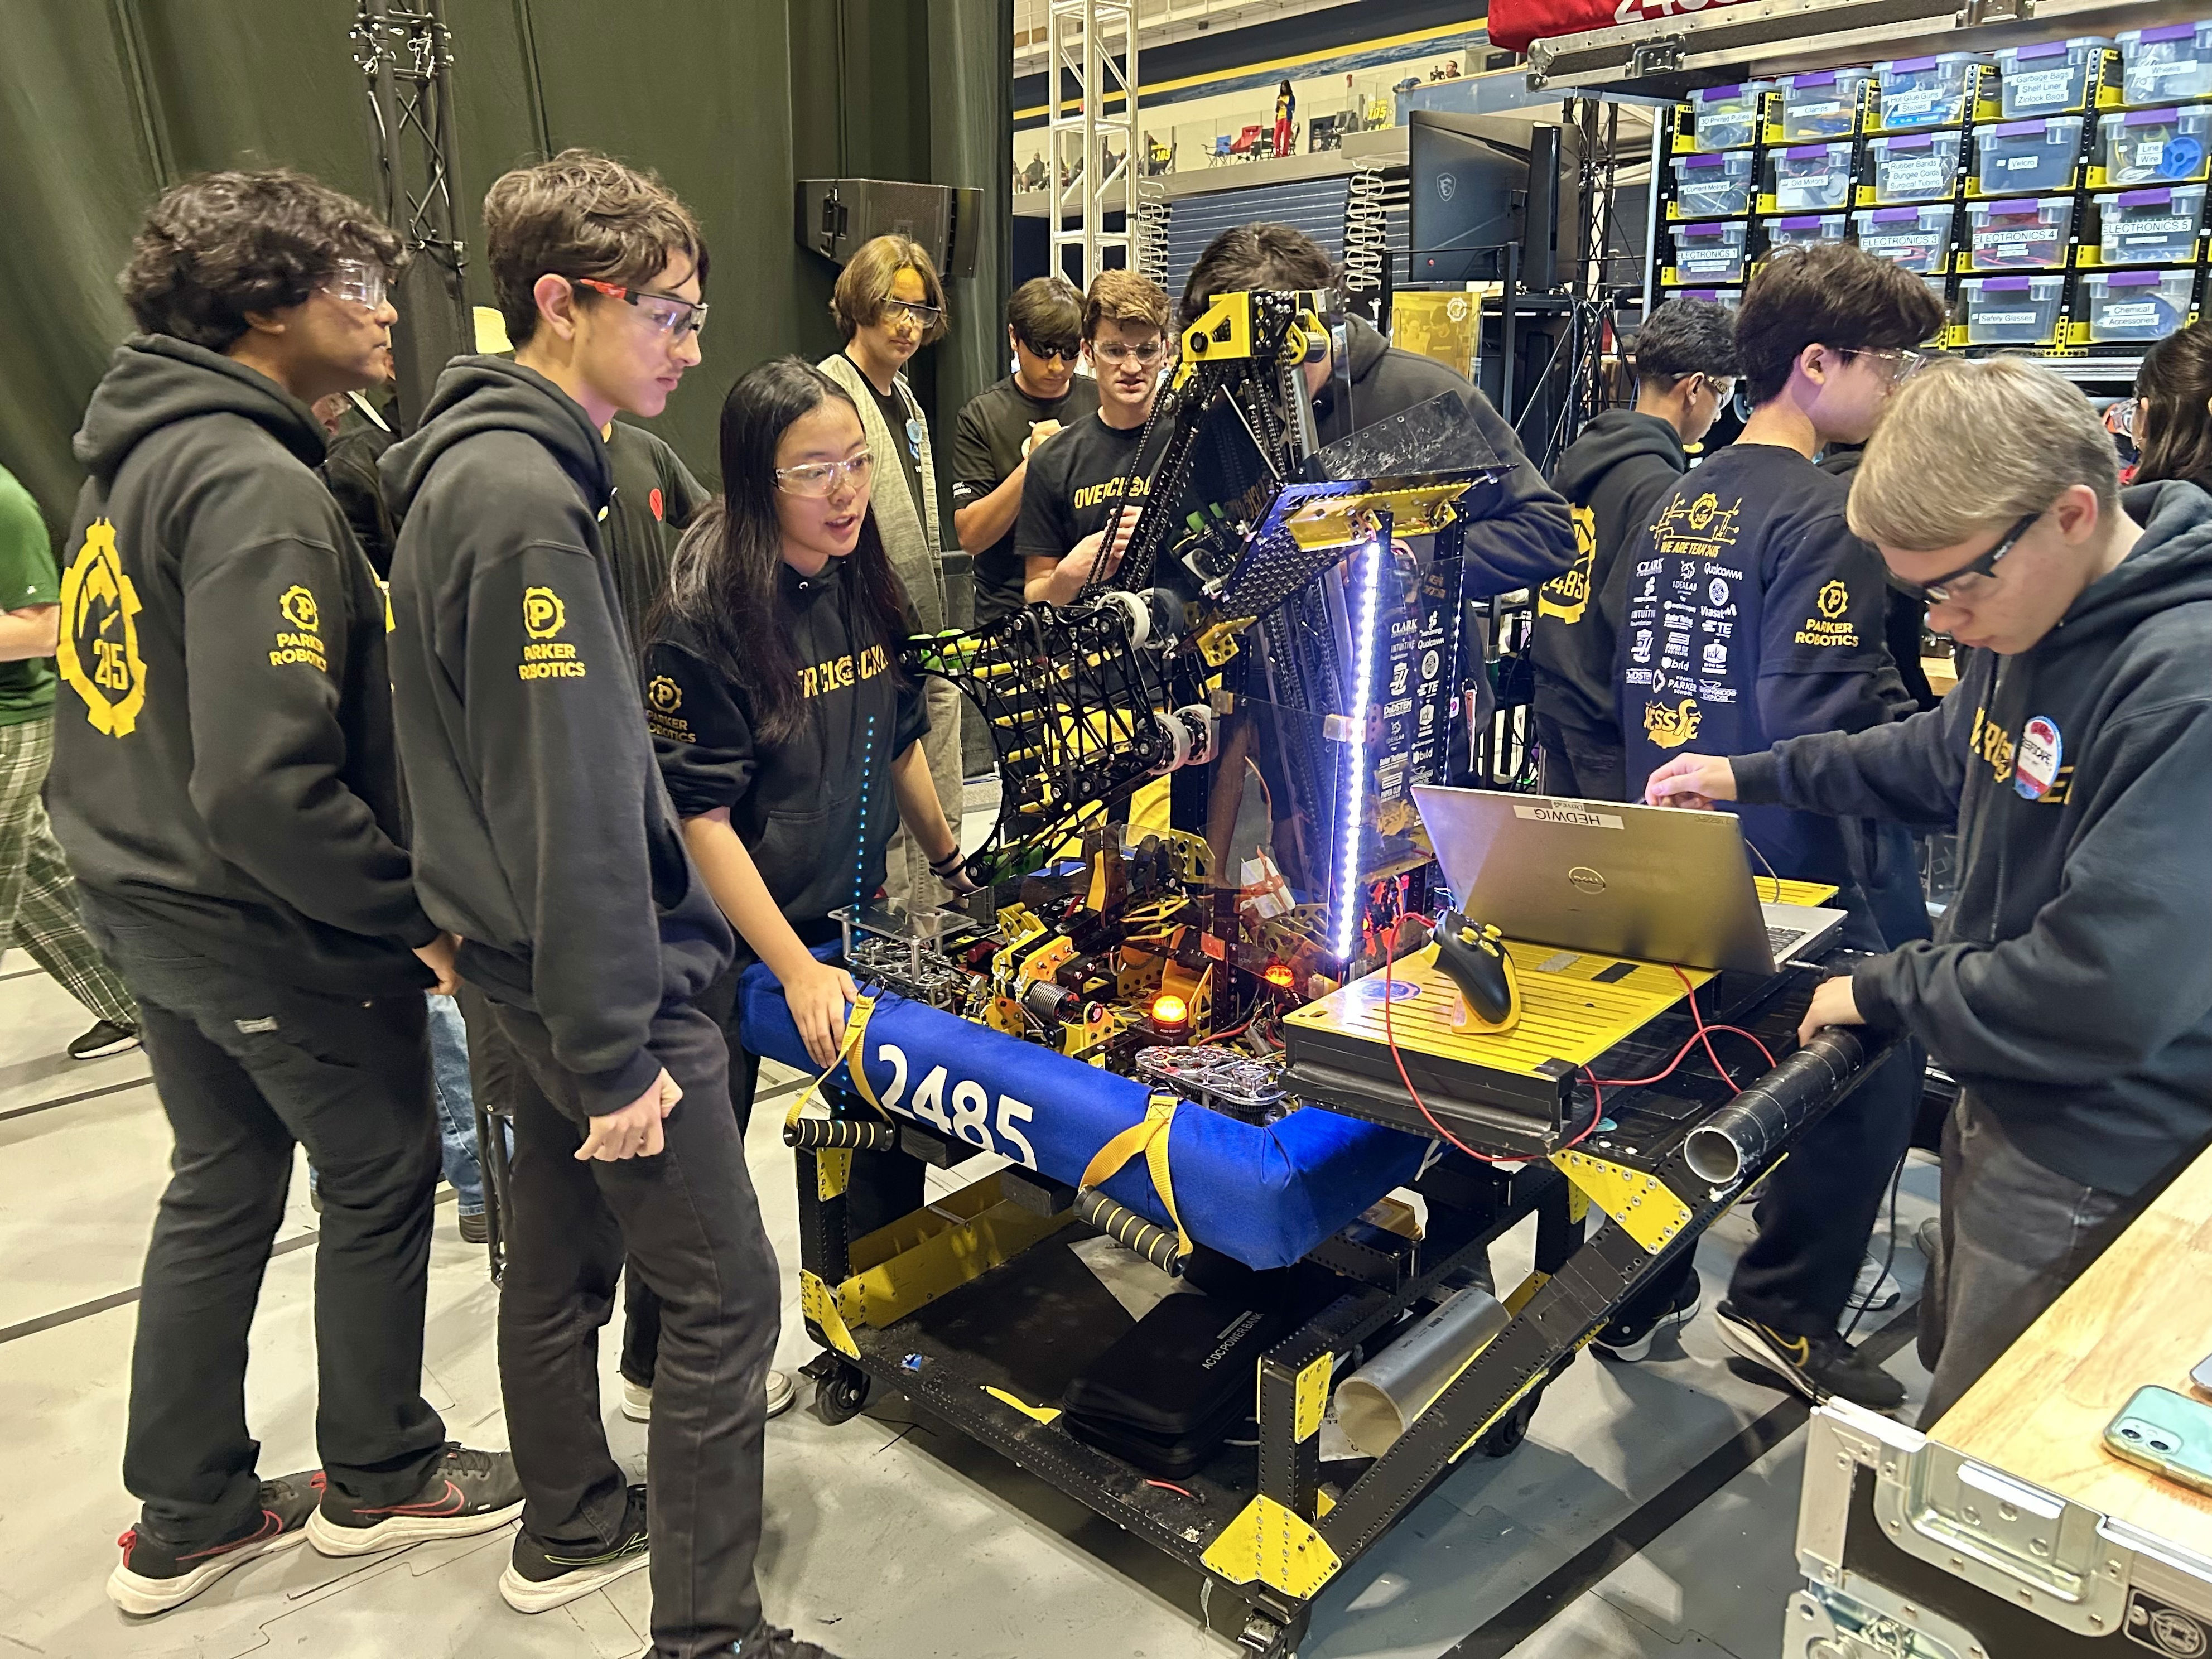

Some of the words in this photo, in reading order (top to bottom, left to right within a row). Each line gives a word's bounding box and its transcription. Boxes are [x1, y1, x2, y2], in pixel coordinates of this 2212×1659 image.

[2016, 73, 2049, 84] Garbage
[2050, 71, 2069, 81] Bags
[2022, 83, 2042, 93] Shelf
[2044, 83, 2062, 91] Liner
[1903, 93, 1919, 102] Glue
[1921, 91, 1939, 100] Guns
[2018, 94, 2044, 104] Ziplock
[2046, 92, 2065, 102] Bags
[1805, 105, 1828, 114] Clamps
[1710, 115, 1729, 124] Printed
[1156, 149, 1171, 161] 105
[2141, 155, 2159, 163] Wire
[1891, 161, 1914, 170] Rubber
[1916, 160, 1936, 168] Bands
[2011, 159, 2035, 167] Velcro
[1803, 176, 1825, 185] Motors
[1893, 171, 1919, 181] Bungee
[1920, 169, 1940, 177] Cords
[1708, 183, 1728, 191] Motors
[1890, 180, 1917, 190] Surgical
[1917, 179, 1940, 187] Tubing
[2103, 221, 2180, 234] ELECTRONICS
[2182, 220, 2189, 230] 5
[1863, 237, 1929, 247] ELECTRONICS
[1974, 231, 2047, 243] ELECTRONICS
[1676, 249, 1730, 259] ELECTRONICS
[1732, 249, 1736, 257] 1
[2114, 305, 2150, 314] Chemical
[2005, 314, 2033, 322] Glasses
[2109, 316, 2155, 326] Accessories
[1660, 541, 1674, 553] WE
[1674, 542, 1689, 554] ARE
[1688, 542, 1707, 556] TEAM
[1637, 558, 1664, 573] CLARK
[1704, 562, 1743, 581] Qualcomm
[1700, 605, 1725, 619] Viasat
[1391, 619, 1418, 634] CLARK
[1718, 621, 1733, 635] TE
[1806, 618, 1853, 634] PARKER
[1418, 637, 1445, 650] Qualcomm
[1795, 631, 1860, 647] ROBOTICS
[1391, 639, 1415, 653] INTUITIVE
[1671, 659, 1690, 671] bild
[1428, 679, 1439, 694] TE
[1668, 679, 1697, 693] PARKER
[646, 709, 688, 731] PARKER
[1644, 706, 1702, 740] NESSIE
[649, 722, 697, 743] OBOTICS
[1419, 747, 1433, 761] bild
[1534, 808, 1601, 826] HEDWIG
[1574, 875, 1602, 886] DELL
[878, 1044, 1037, 1172] 2485
[1202, 1358, 1217, 1370] AC
[1210, 1349, 1226, 1360] DC
[1219, 1327, 1249, 1351] POWER
[1241, 1312, 1265, 1329] BANK
